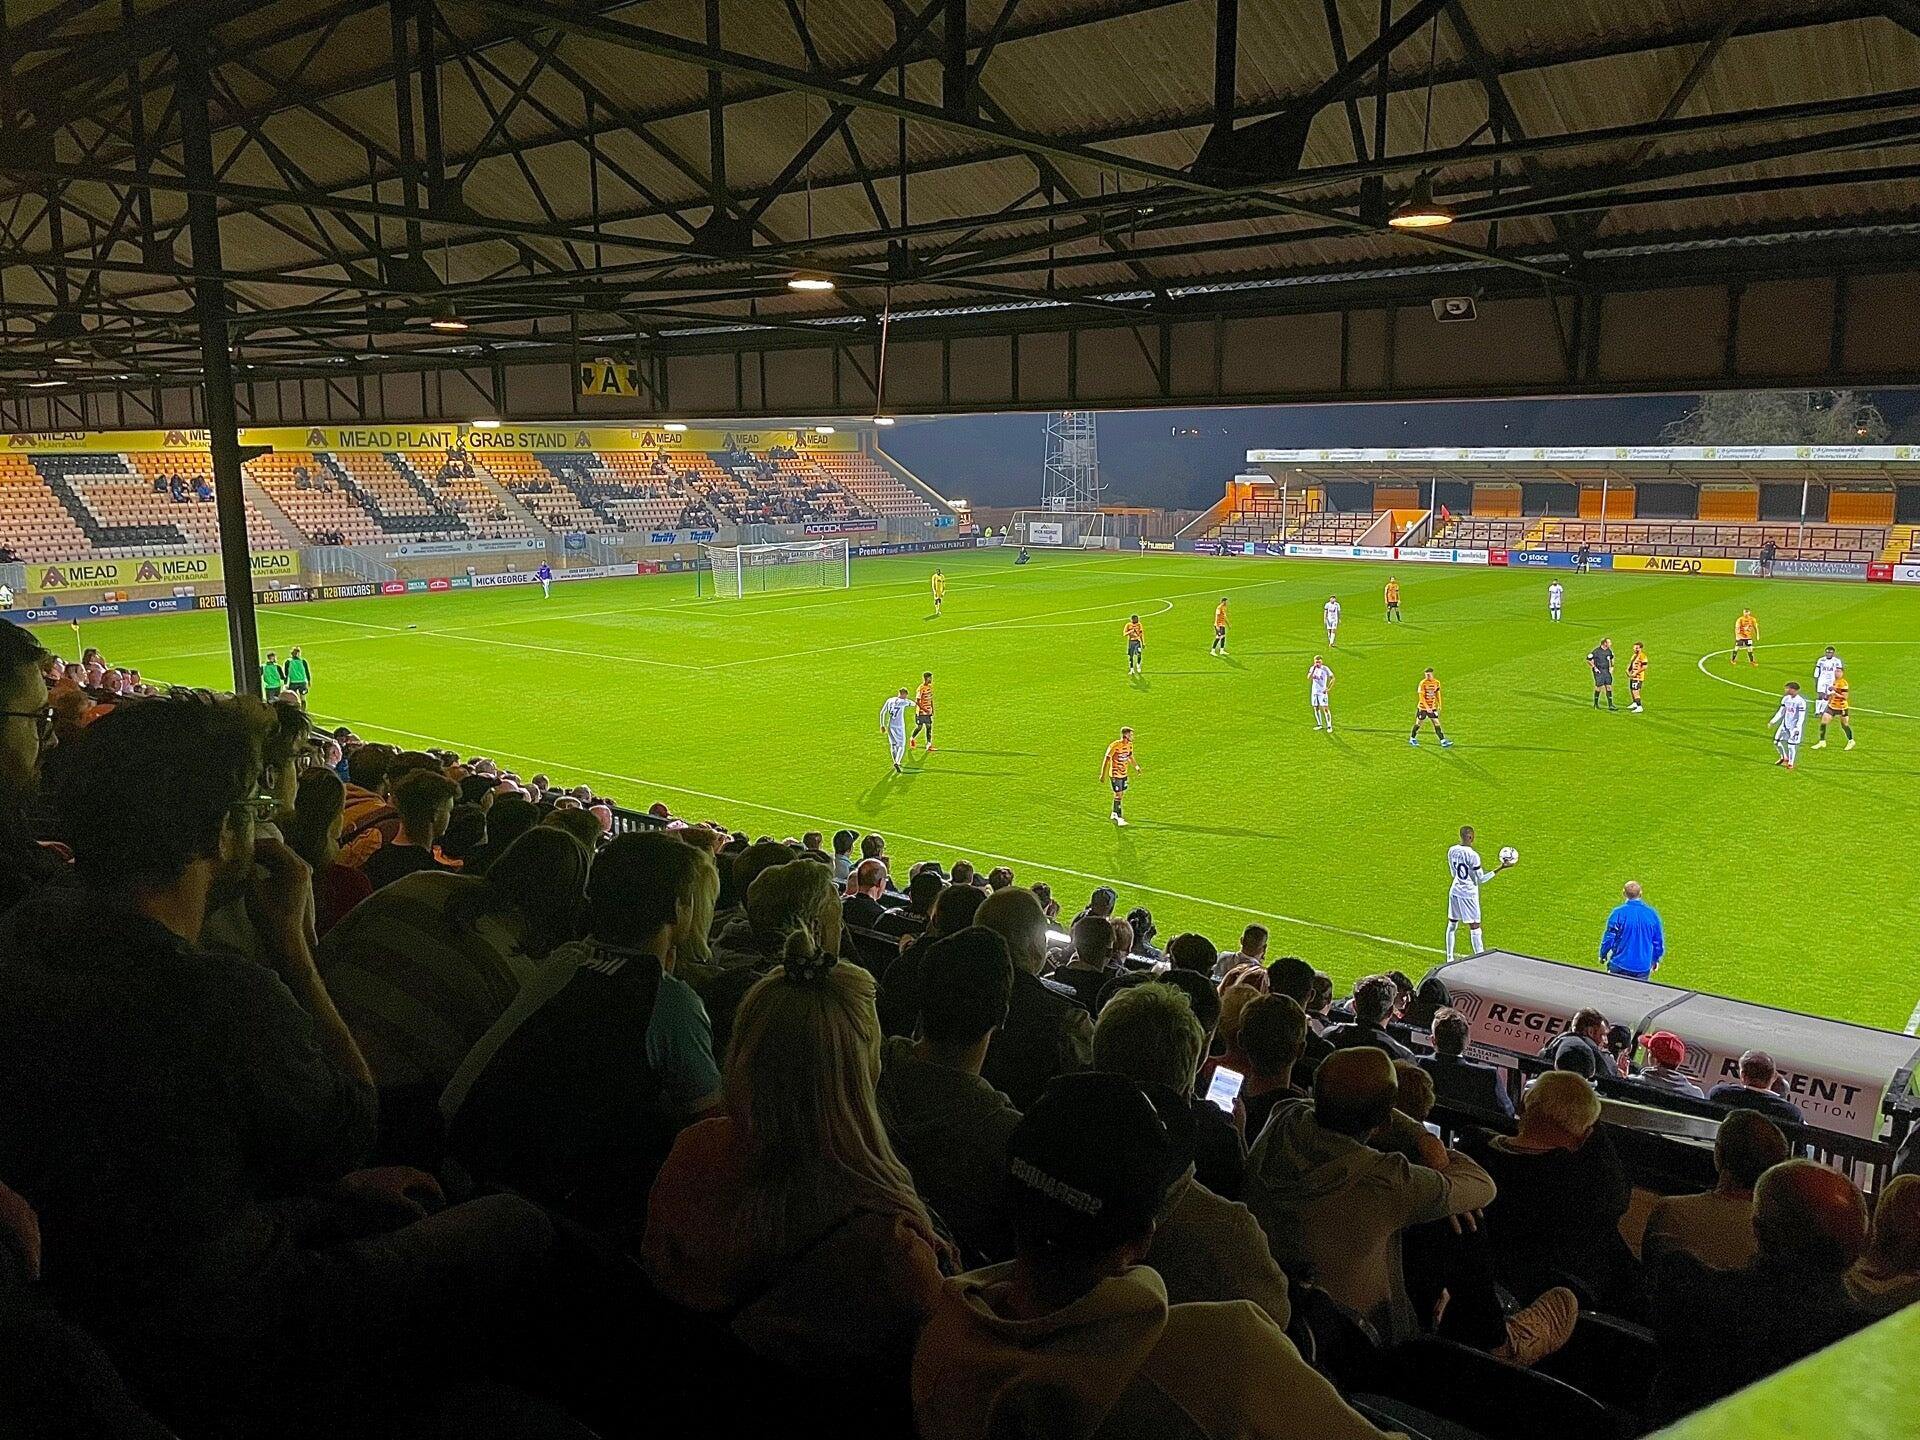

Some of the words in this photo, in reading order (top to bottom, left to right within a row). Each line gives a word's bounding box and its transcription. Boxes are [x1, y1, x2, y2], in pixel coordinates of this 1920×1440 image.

[601, 365, 622, 393] A
[190, 430, 211, 441] ME
[340, 431, 392, 447] MEAD
[396, 431, 451, 447] PLANT
[456, 433, 466, 448] &
[470, 432, 515, 447] GRAB
[518, 433, 567, 448] STAND
[656, 433, 682, 443] MEAD
[736, 434, 759, 443] MEAD
[807, 435, 828, 444] MEAD
[805, 524, 841, 534] ADCOCK
[651, 532, 676, 544] Thrifty
[690, 531, 714, 541] Thrifty
[859, 547, 886, 556] Premier
[1147, 541, 1175, 550] hummel
[162, 560, 207, 574] MEAD
[250, 555, 289, 568] MEAD
[1661, 559, 1702, 571] MEAD
[1801, 561, 1860, 569] CONTRACTORS
[69, 565, 117, 580] MEAD
[1795, 566, 1851, 574] LANDSCAPING
[476, 577, 496, 586] MICK
[497, 575, 527, 584] GEORGE
[263, 590, 303, 604] A2BTAXIC
[323, 584, 370, 599] A2BTAXICABS
[1488, 1003, 1573, 1036] REGE
[1484, 1022, 1547, 1044] CONSTR
[1720, 1057, 1862, 1106] RENT
